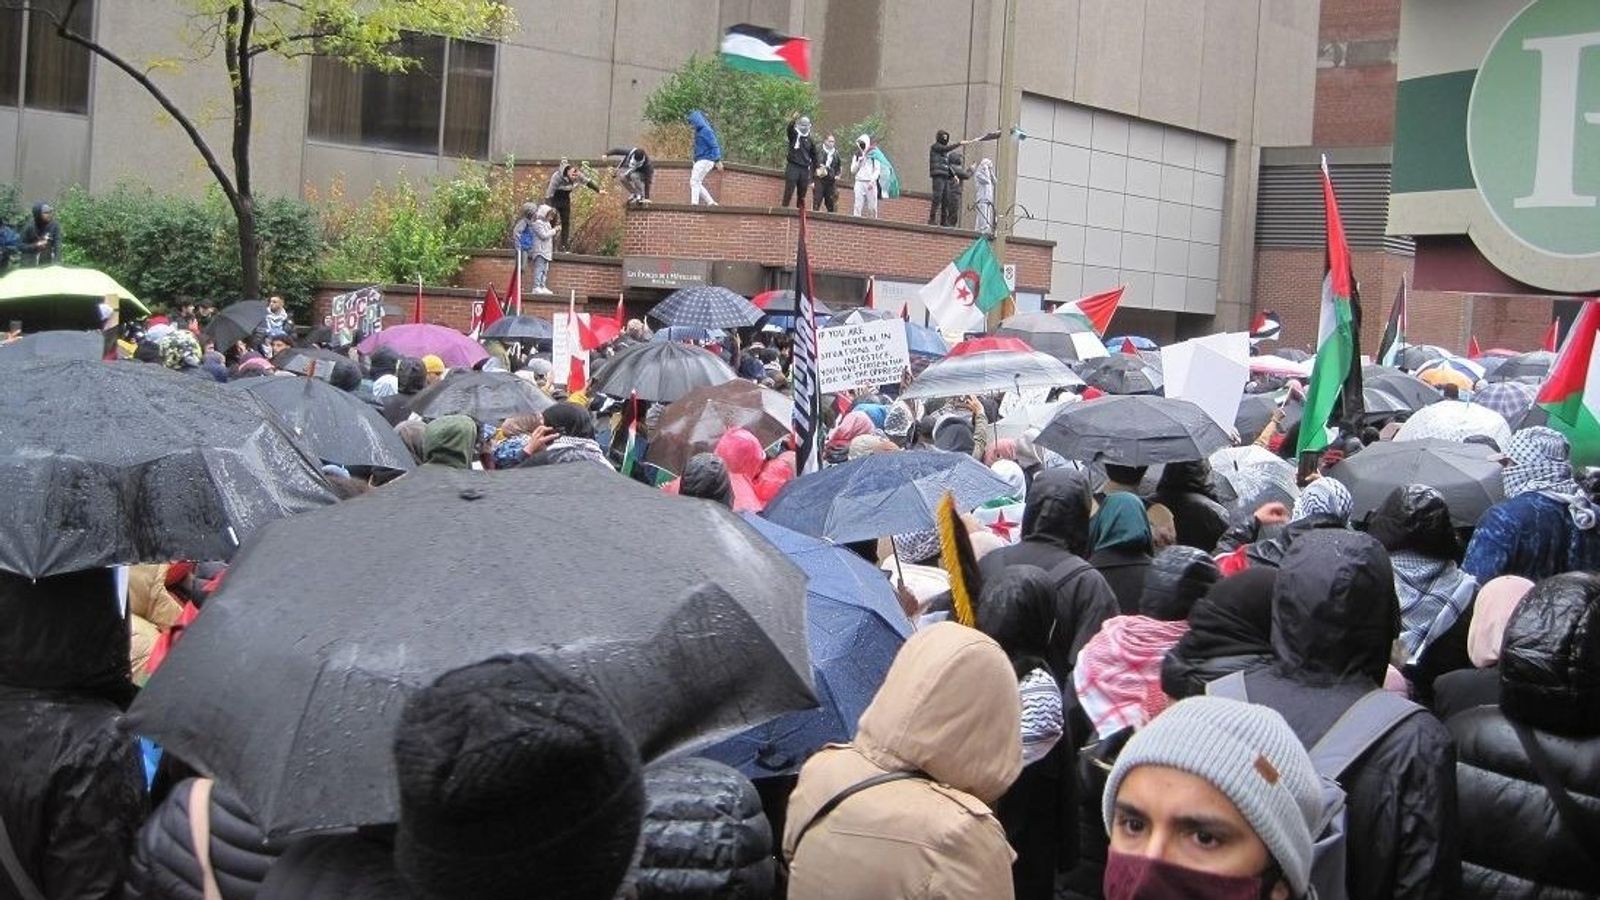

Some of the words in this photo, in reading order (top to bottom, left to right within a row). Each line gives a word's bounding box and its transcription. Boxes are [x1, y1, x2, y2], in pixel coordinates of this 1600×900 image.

[829, 329, 846, 338] YOU
[848, 327, 863, 336] ARE
[880, 332, 892, 340] IN
[875, 344, 885, 352] OF
